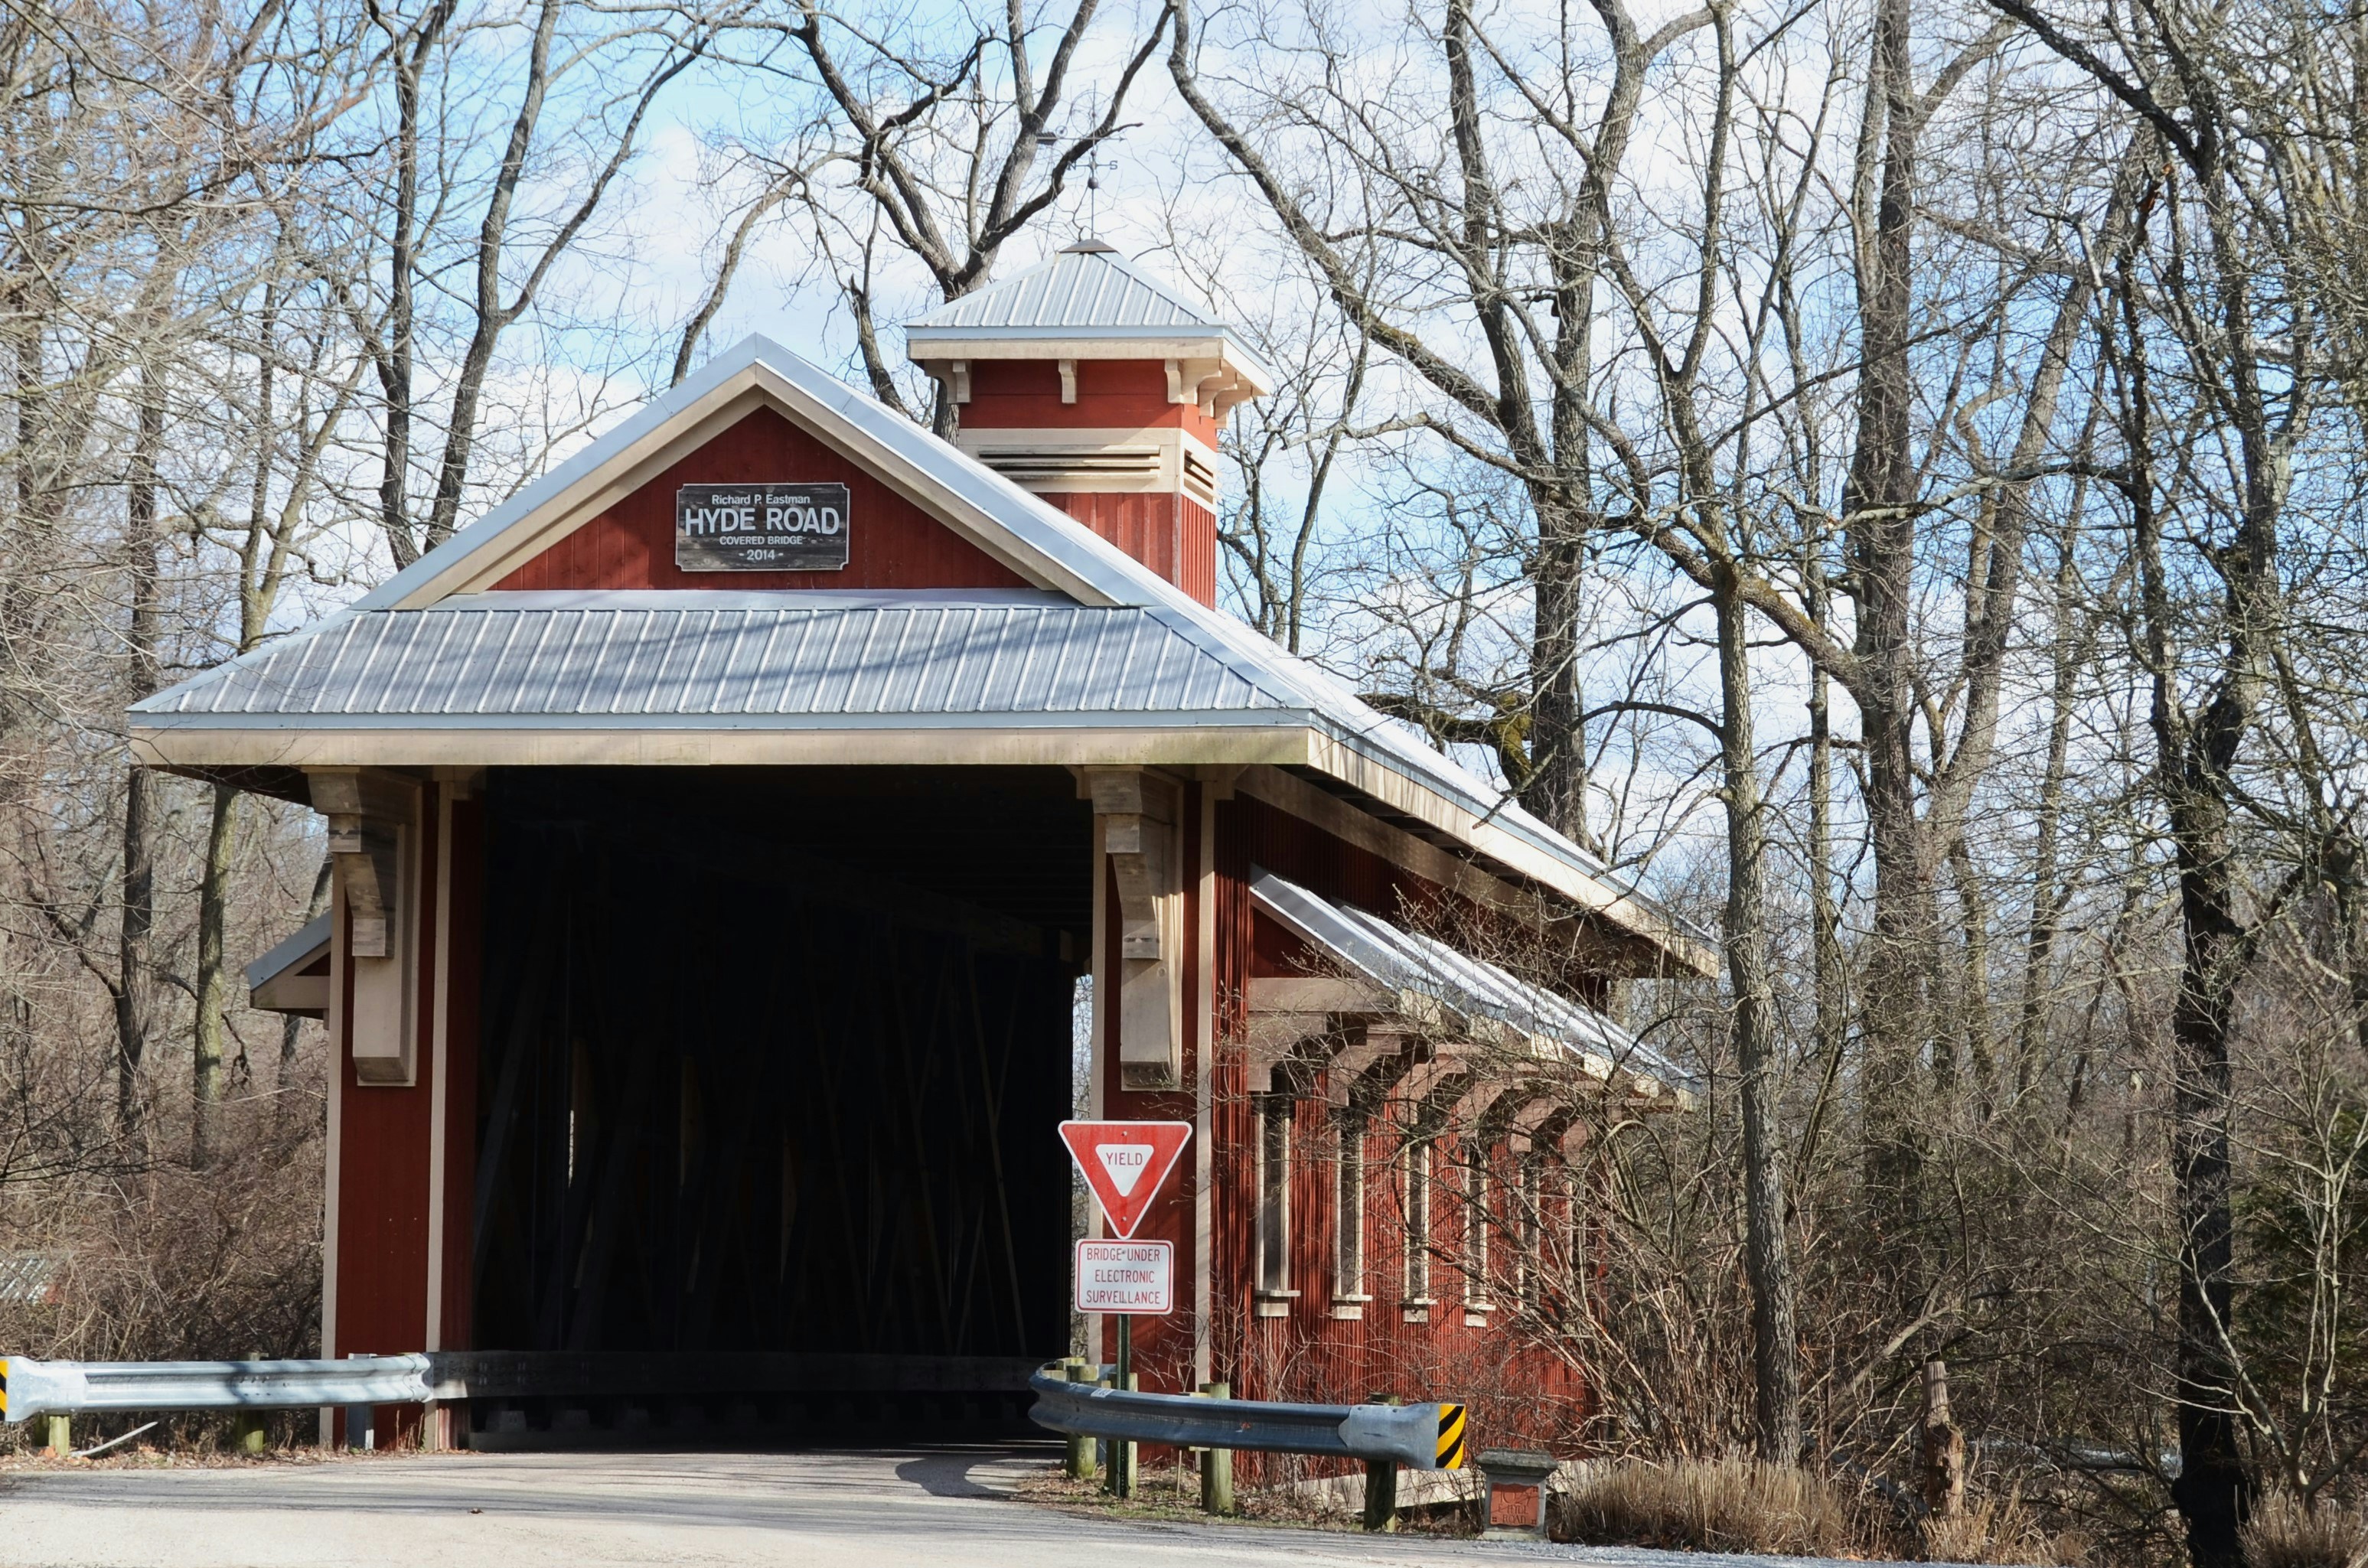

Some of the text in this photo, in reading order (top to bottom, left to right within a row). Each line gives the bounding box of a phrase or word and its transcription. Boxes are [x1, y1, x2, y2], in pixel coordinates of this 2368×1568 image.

[712, 494, 811, 505] Richard P. Eastman
[685, 507, 840, 536] HYDE ROAD
[719, 536, 803, 545] COVERED BRIDGE
[1106, 1152, 1143, 1165] YIELD
[1087, 1248, 1160, 1262] BRIDGE UNDER
[1095, 1270, 1155, 1283] ELECTRONIC
[1086, 1290, 1161, 1305] SURVEILLANCE
[1502, 1514, 1527, 1524] ROAD
